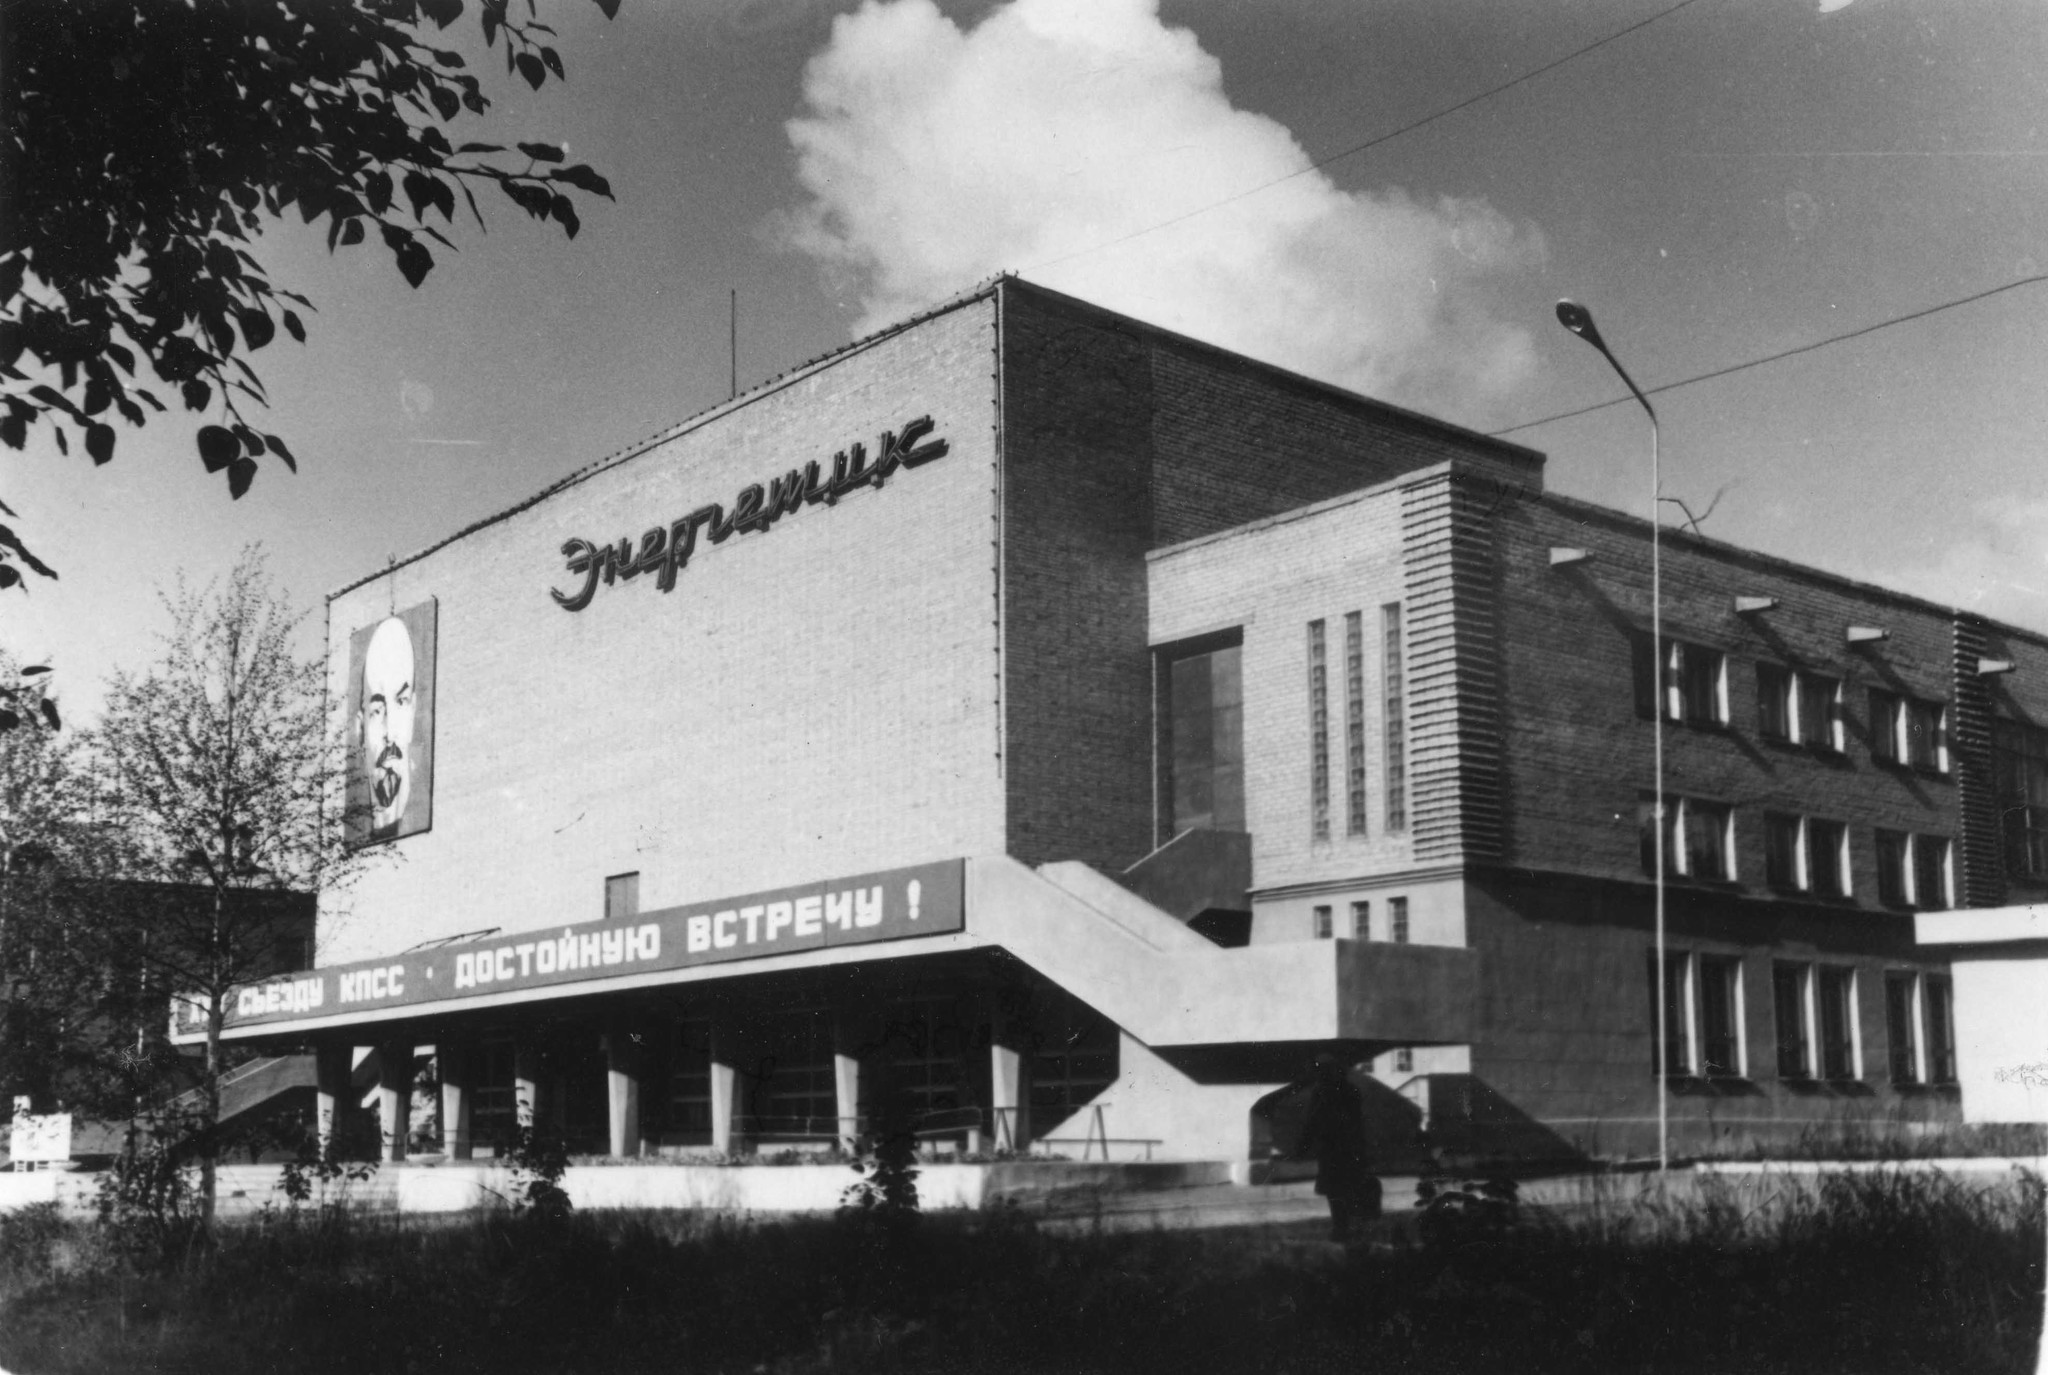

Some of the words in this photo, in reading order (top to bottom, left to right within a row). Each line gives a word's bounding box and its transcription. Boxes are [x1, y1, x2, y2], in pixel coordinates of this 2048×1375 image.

[551, 415, 950, 612] Энергетик
[340, 965, 404, 1003] КПСС
[455, 923, 661, 989] ДОСТОЙНУЮ
